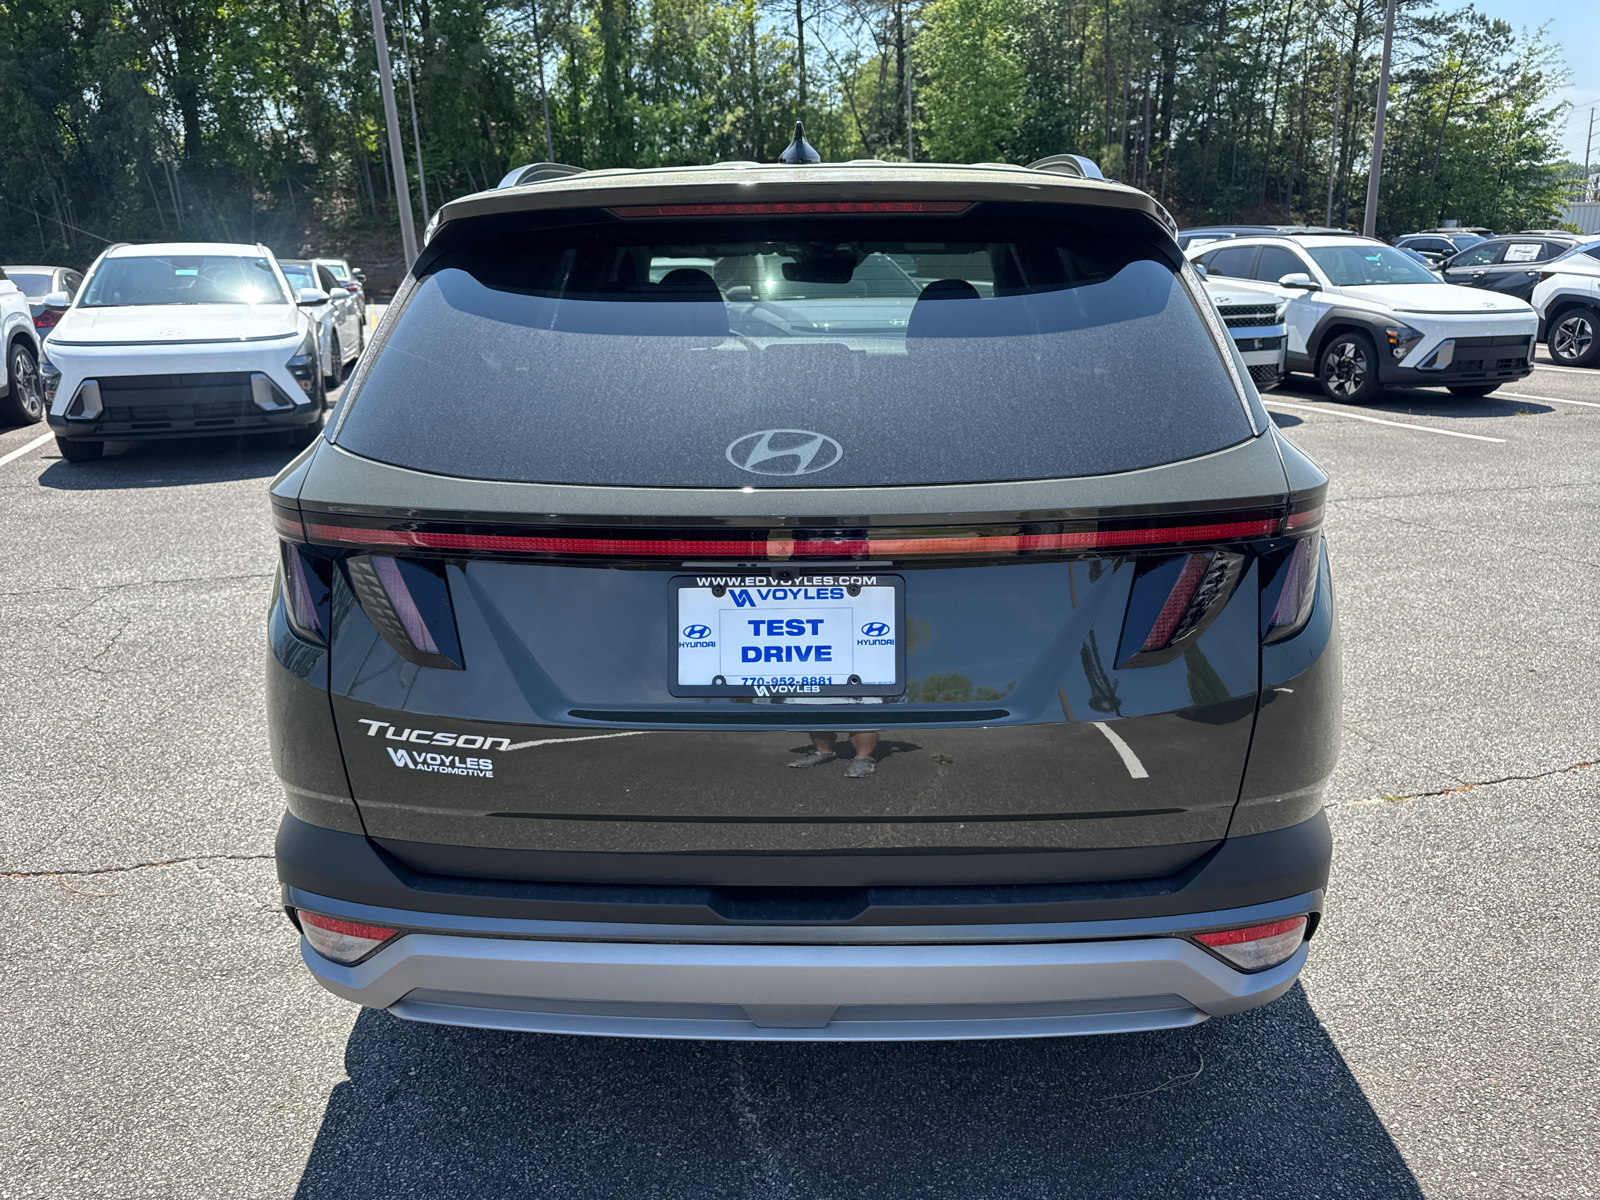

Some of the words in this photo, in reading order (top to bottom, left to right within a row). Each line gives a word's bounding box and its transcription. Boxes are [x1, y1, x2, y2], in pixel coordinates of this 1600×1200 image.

[756, 588, 845, 601] VOYLES
[747, 619, 825, 637] TEST
[857, 638, 895, 646] HYUNDAI
[741, 645, 833, 663] DRIVE
[741, 676, 833, 686] 770-952-8881
[769, 685, 821, 693] VOYLES
[412, 751, 493, 771] VOYLES
[416, 763, 494, 778] AUTOMOTIVE
